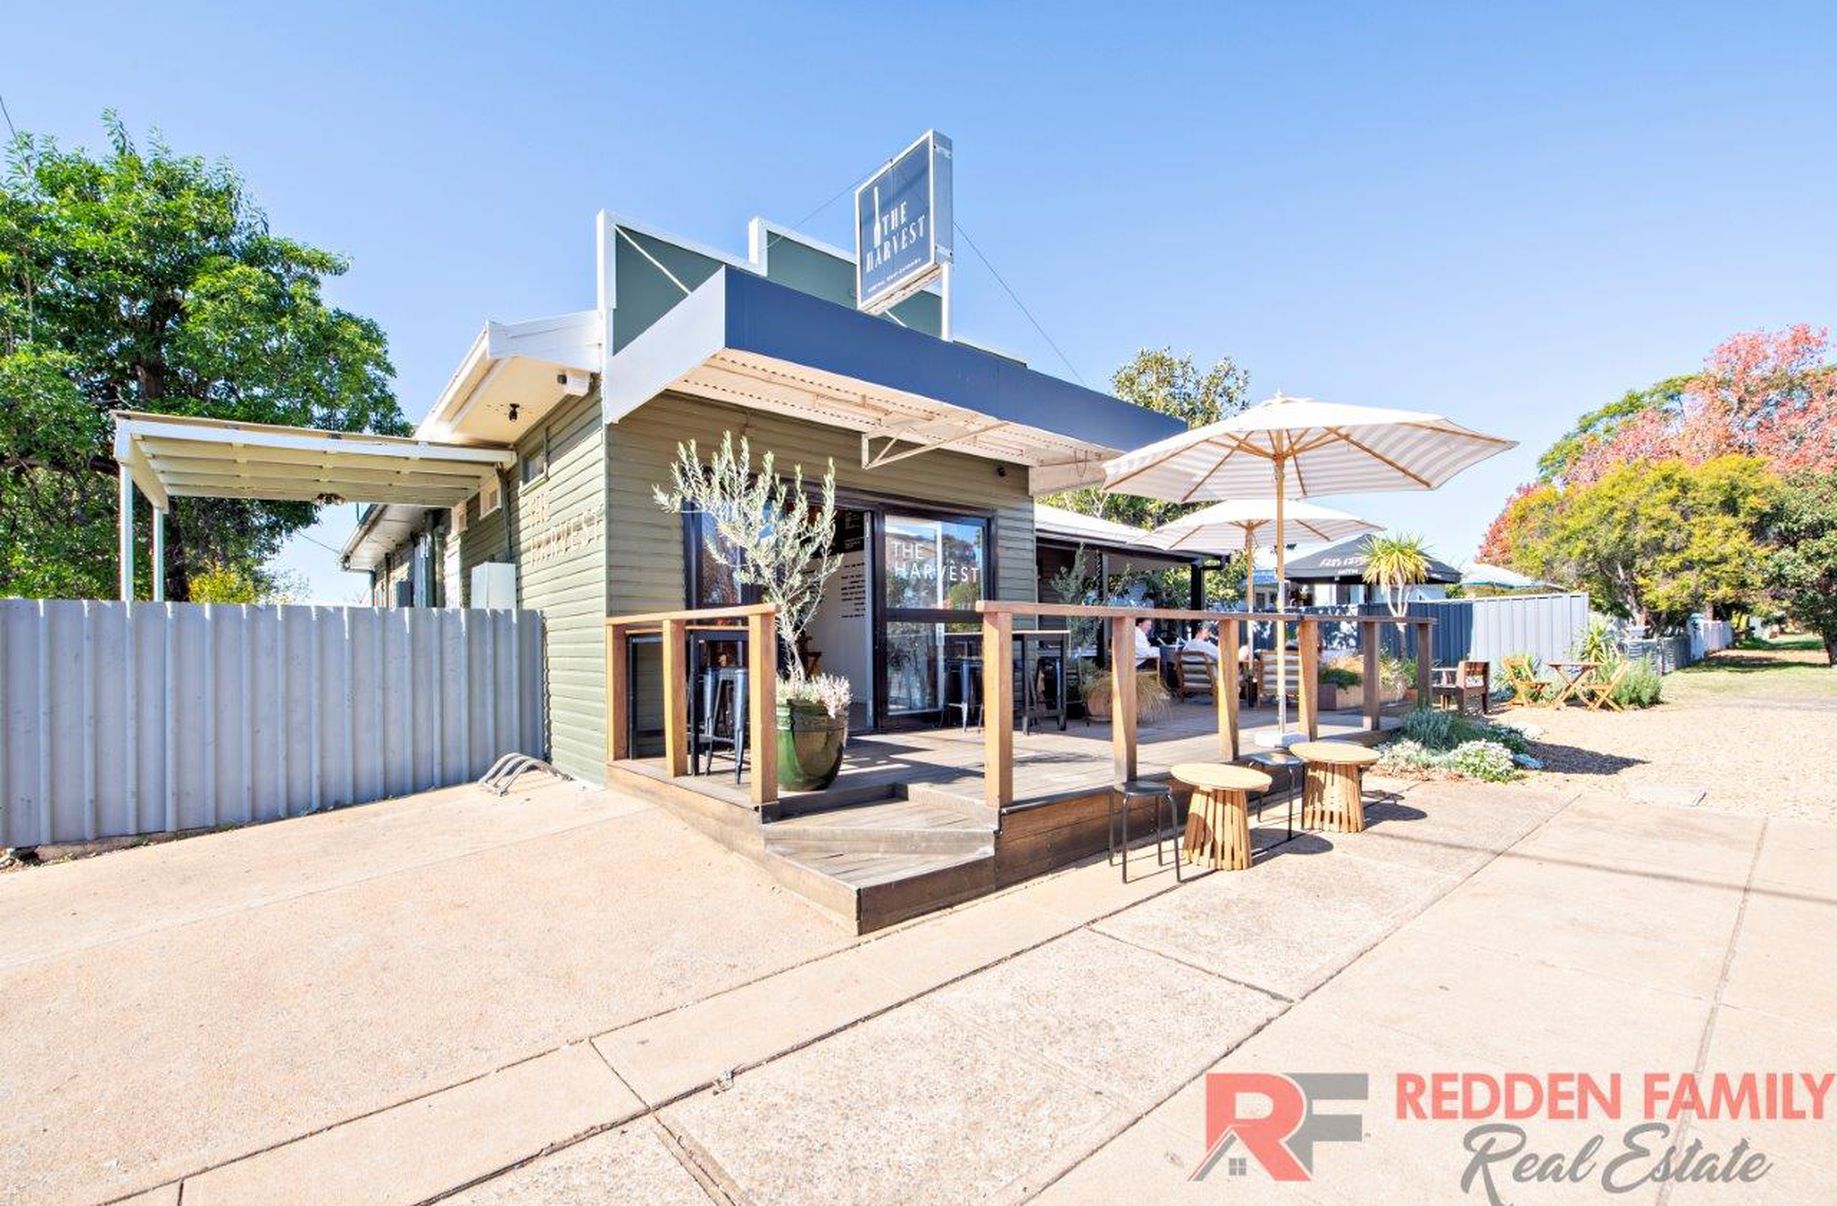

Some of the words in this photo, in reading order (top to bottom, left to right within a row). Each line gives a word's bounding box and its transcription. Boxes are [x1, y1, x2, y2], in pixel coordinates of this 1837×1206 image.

[881, 200, 907, 236] THE
[865, 215, 925, 273] HARVEST
[893, 541, 926, 560] THE
[894, 561, 980, 583] HARVEST
